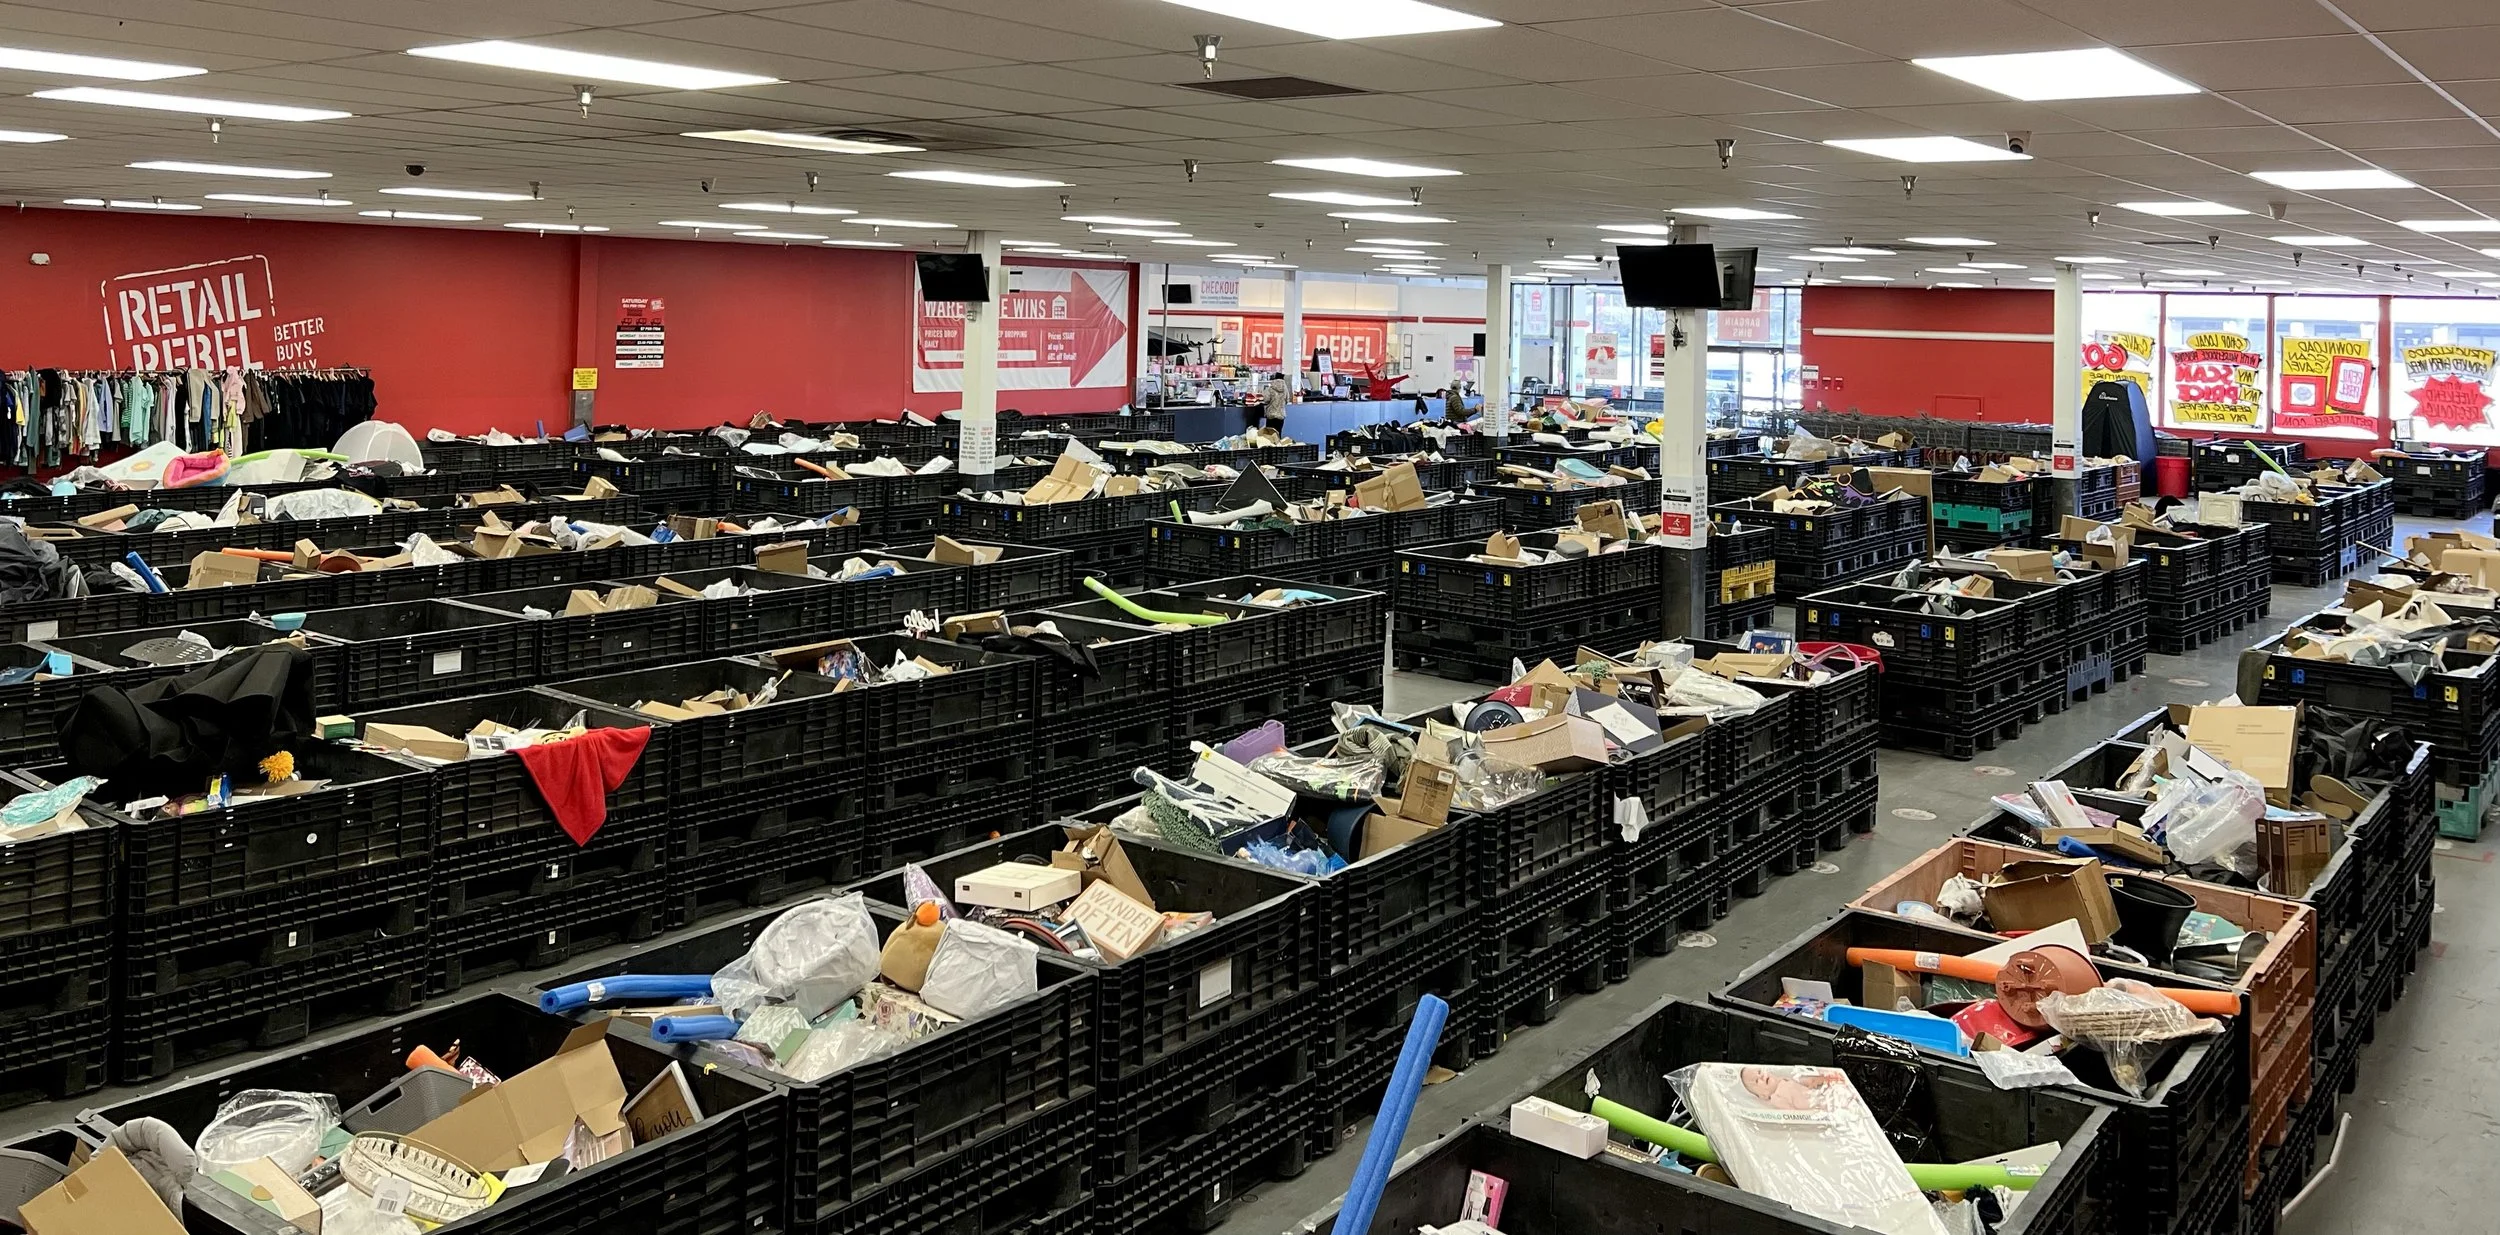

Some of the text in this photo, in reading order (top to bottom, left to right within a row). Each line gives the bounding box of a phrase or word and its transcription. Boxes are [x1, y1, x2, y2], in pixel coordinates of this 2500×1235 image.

[1201, 280, 1239, 295] CHECKOUT
[118, 272, 262, 341] RETAIL
[1013, 298, 1046, 318] WINS
[273, 316, 325, 342] BETTER
[924, 330, 958, 338] PRICES DROP
[276, 340, 313, 362] BUYS
[1251, 331, 1376, 364] RETL REBEL
[1089, 887, 1152, 932] WANDER
[1070, 902, 1140, 948] OFTEN
